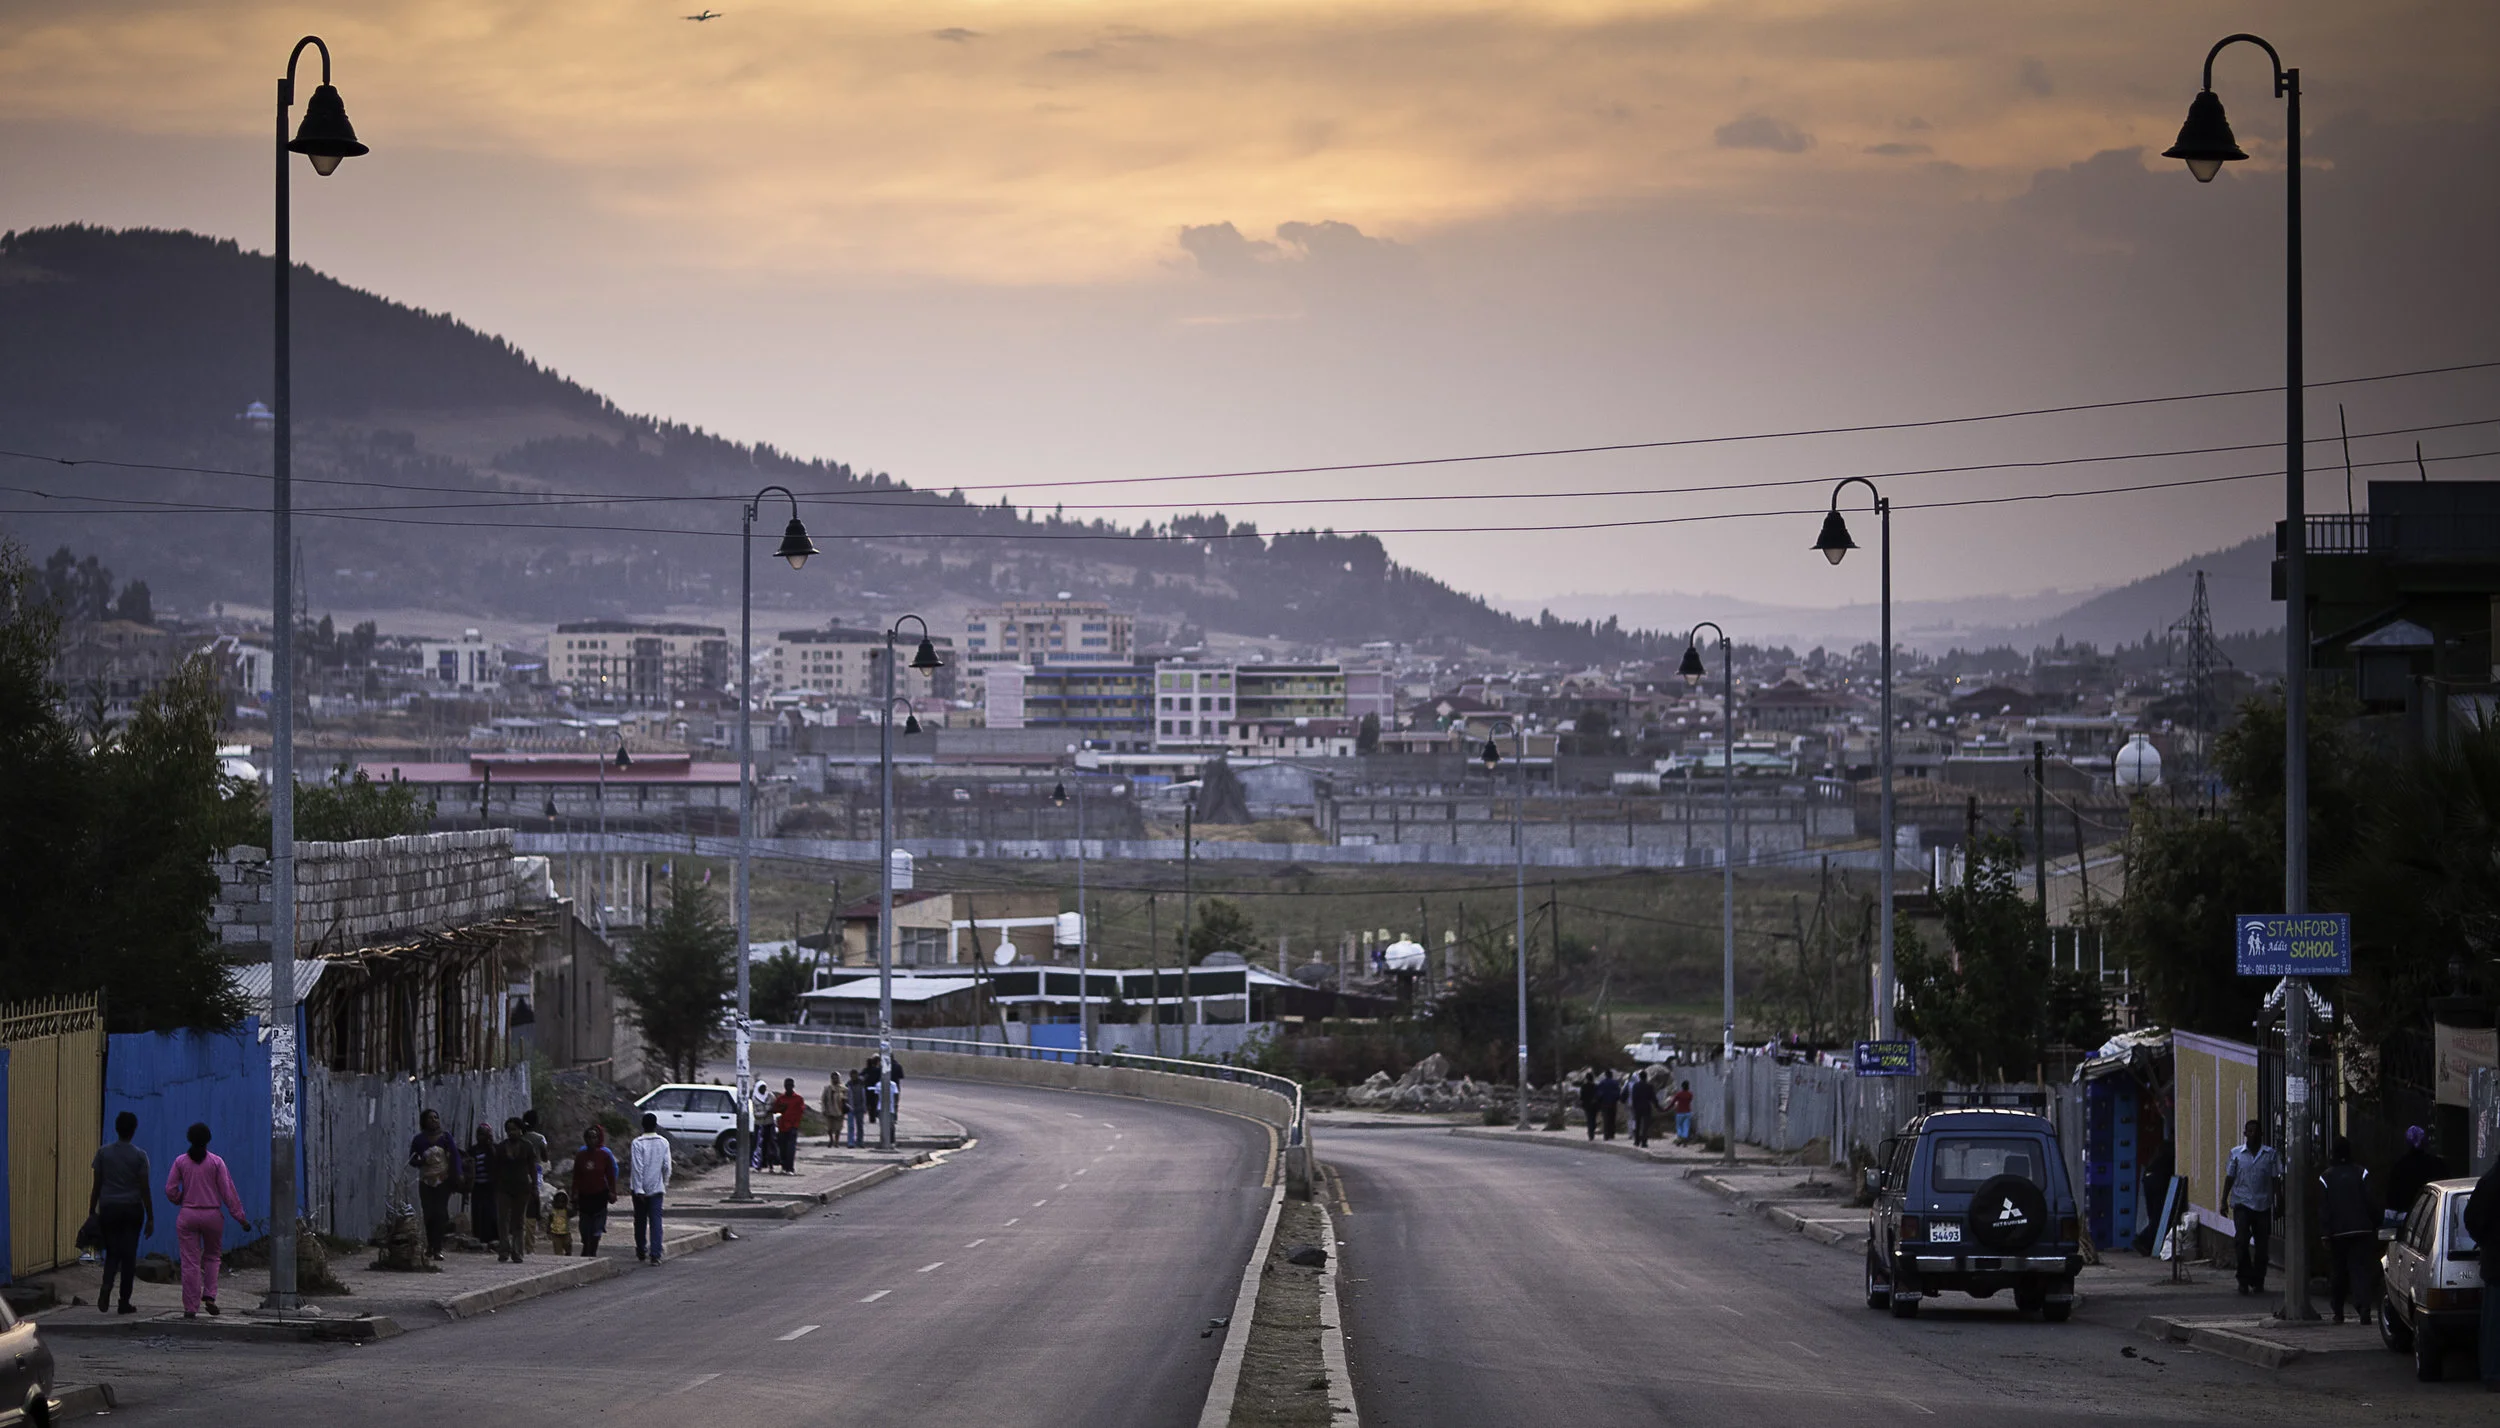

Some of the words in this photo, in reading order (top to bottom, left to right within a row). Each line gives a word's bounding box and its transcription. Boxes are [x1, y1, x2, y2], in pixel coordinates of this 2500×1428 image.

[2267, 919, 2338, 937] STANFORD
[2267, 941, 2288, 952] Addis
[2290, 940, 2338, 959] SCHOOL
[1932, 1231, 1959, 1241] 54493
